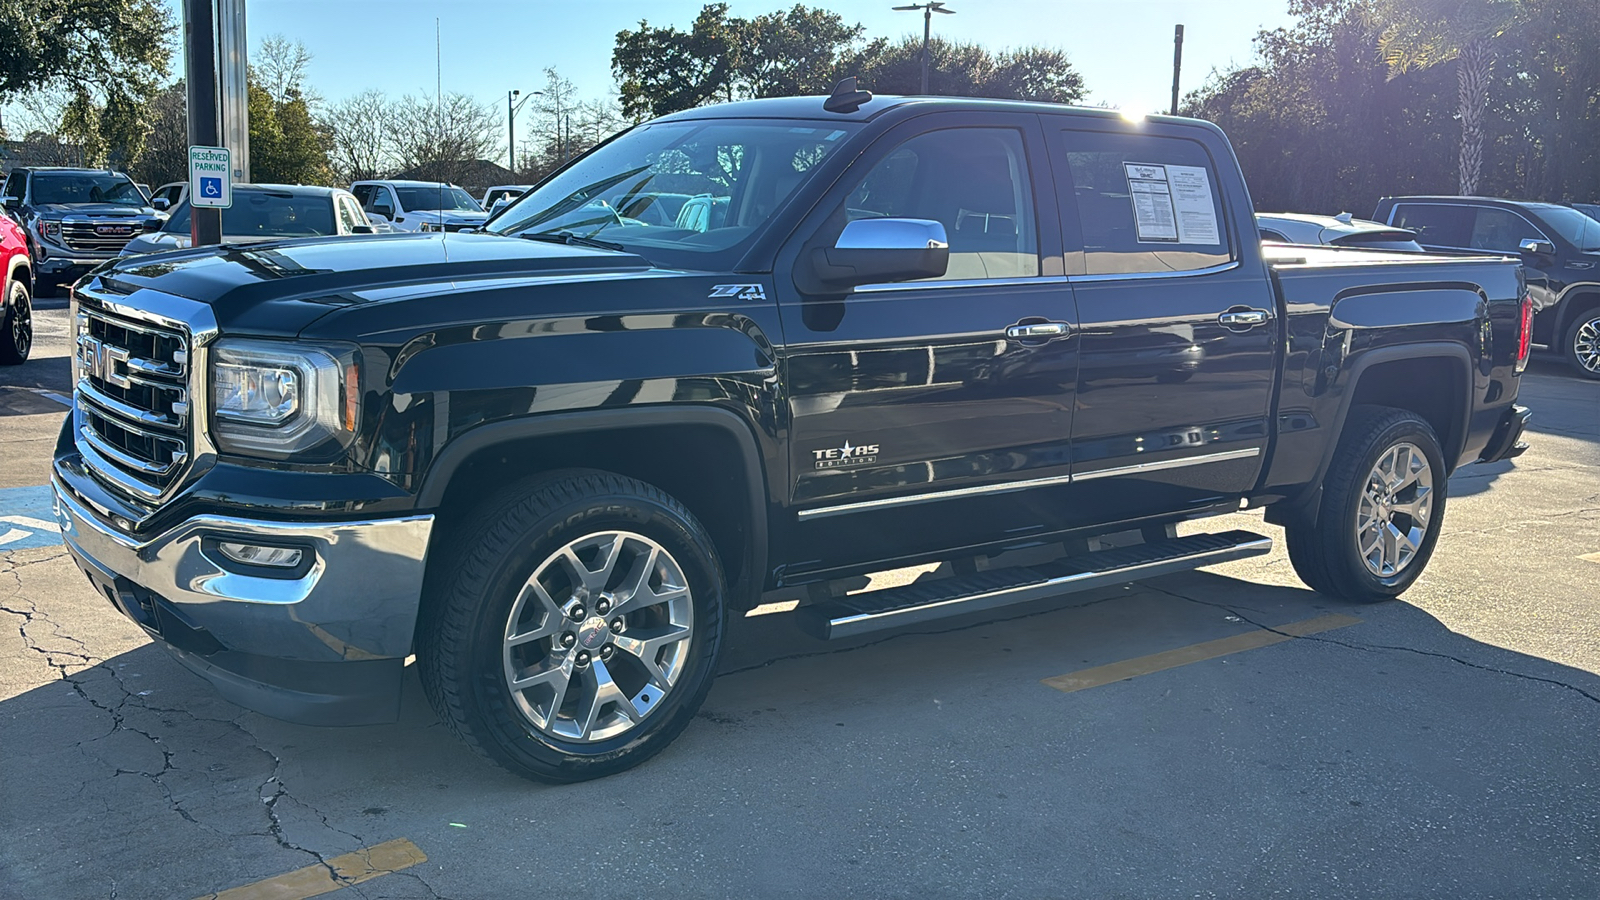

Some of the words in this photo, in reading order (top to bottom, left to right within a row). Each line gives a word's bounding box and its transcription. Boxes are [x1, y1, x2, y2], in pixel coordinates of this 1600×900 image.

[192, 151, 228, 162] RESERVED
[194, 162, 226, 172] PARKING
[97, 226, 132, 234] GMC
[82, 335, 131, 390] GMC
